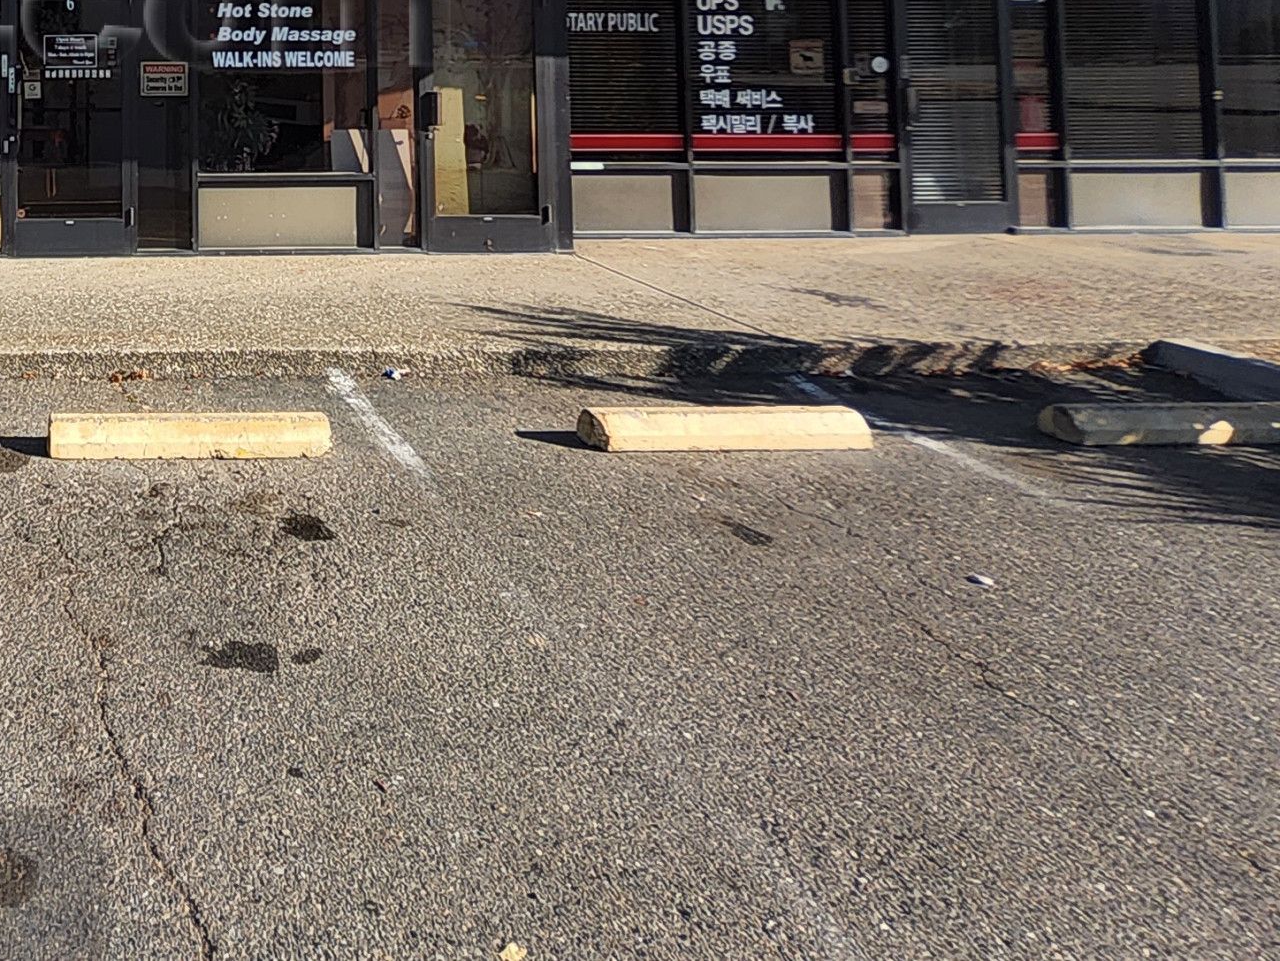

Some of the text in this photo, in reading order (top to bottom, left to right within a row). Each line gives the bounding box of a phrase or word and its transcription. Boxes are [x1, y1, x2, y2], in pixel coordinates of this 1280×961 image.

[217, 3, 314, 18] Hot Stone
[567, 12, 660, 32] TARY PUBLIC
[696, 14, 755, 36] USPS
[217, 26, 357, 45] Body Massage
[212, 51, 355, 68] WALK-INS WELCOME
[697, 40, 737, 62] 공증
[145, 65, 184, 73] WARNING
[699, 64, 732, 84] 우표
[145, 76, 167, 84] Security
